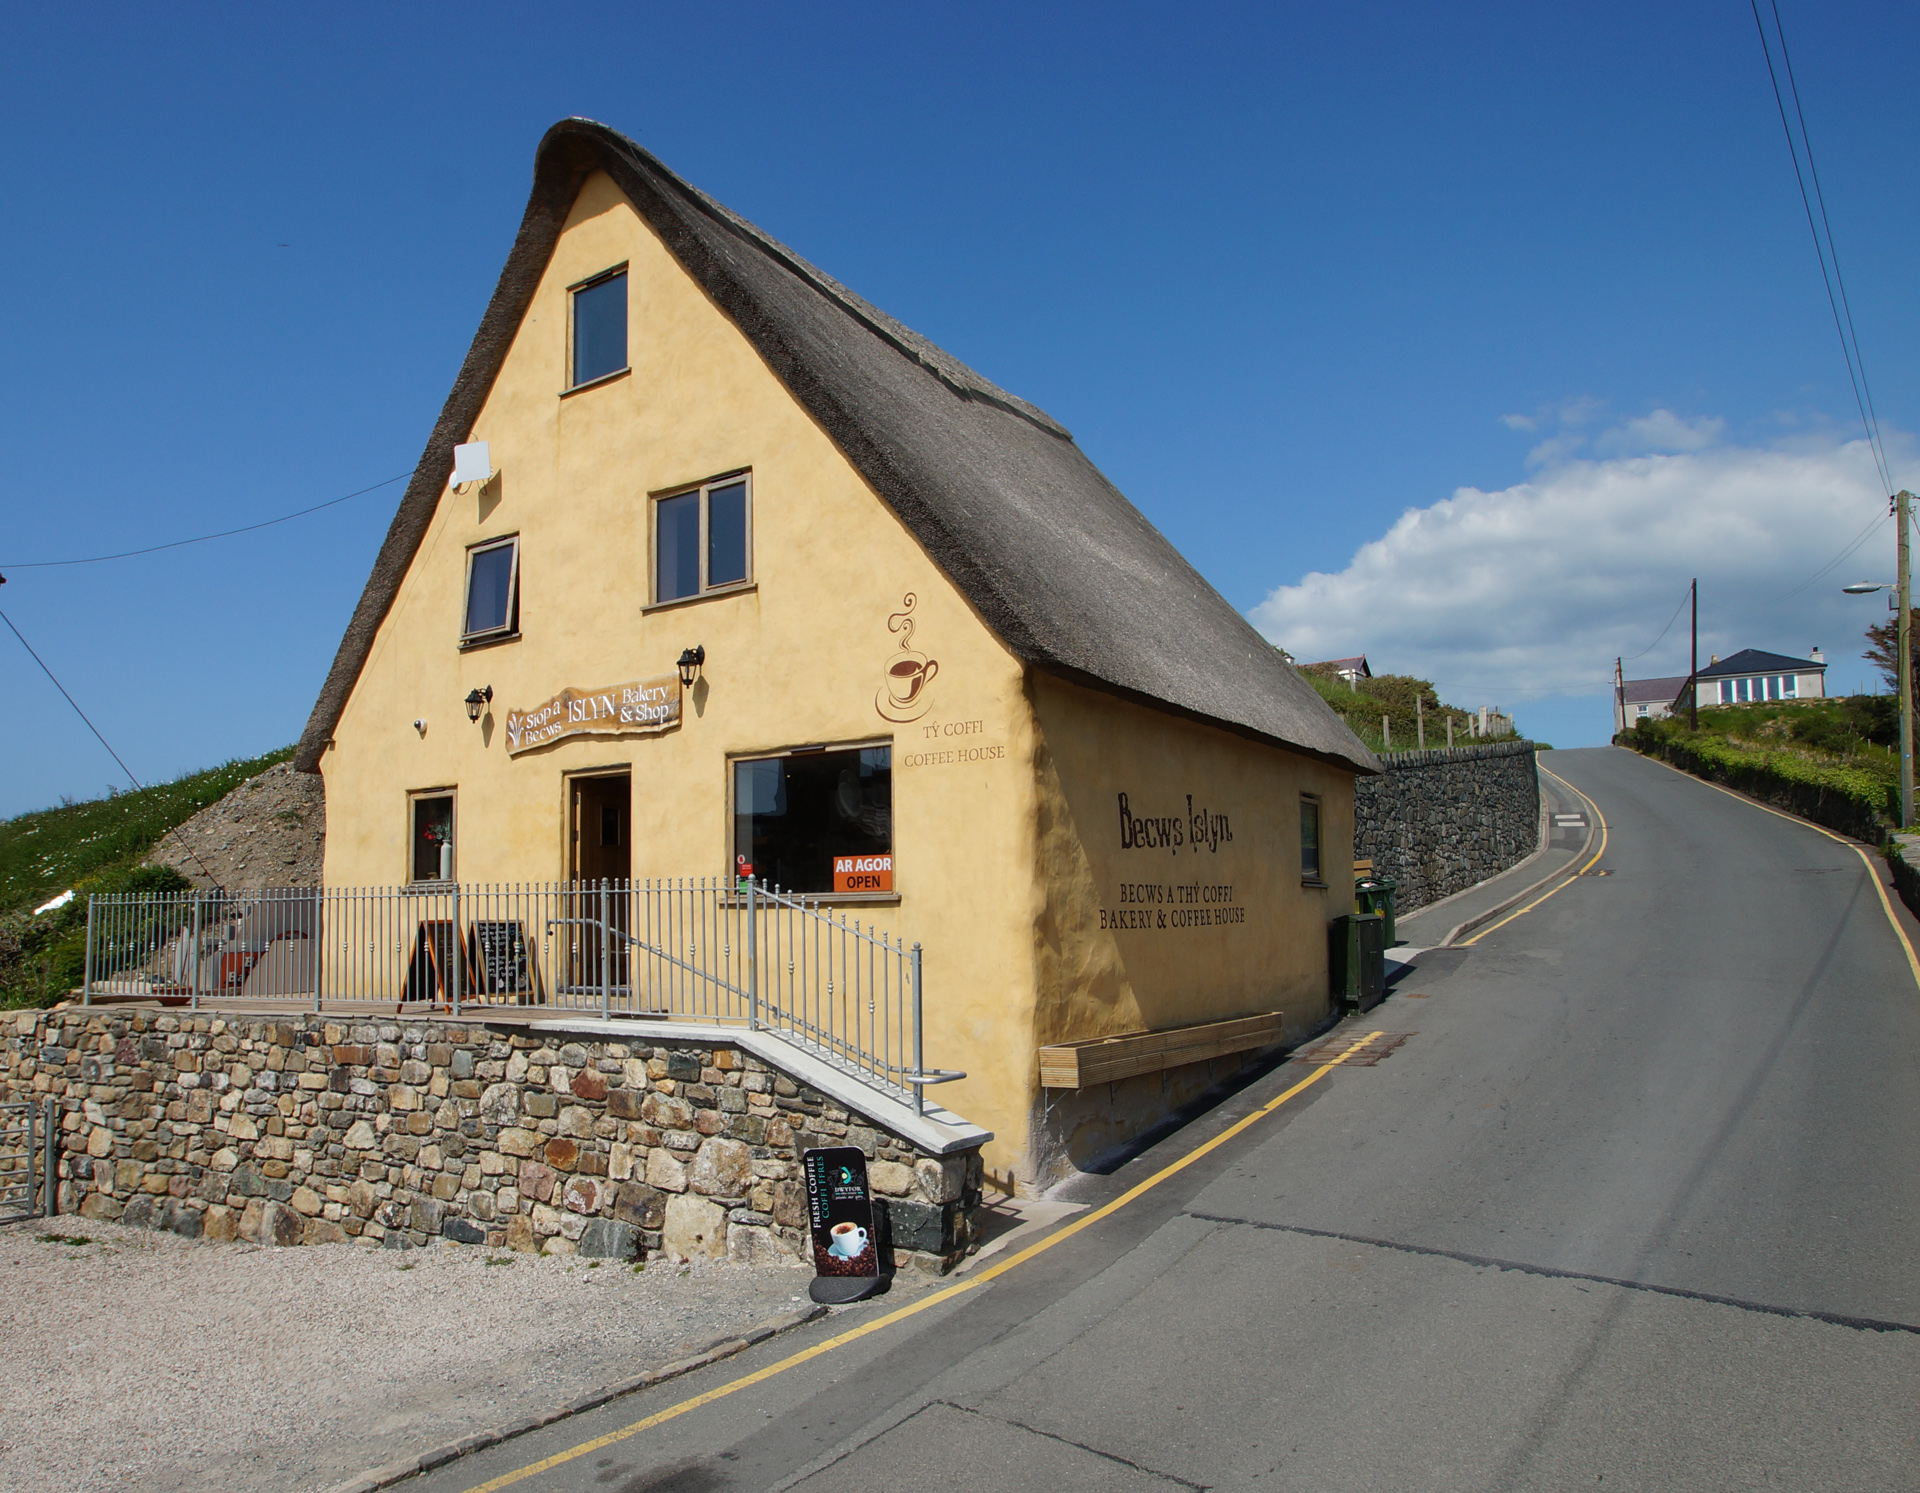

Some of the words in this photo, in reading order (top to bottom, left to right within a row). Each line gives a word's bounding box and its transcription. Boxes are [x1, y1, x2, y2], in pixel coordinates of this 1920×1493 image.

[622, 684, 669, 705] Bakery
[526, 706, 551, 731] Siop
[552, 701, 561, 715] a
[567, 694, 615, 723] ISLYN
[620, 706, 634, 723] &
[635, 703, 669, 723] Shop
[525, 721, 562, 745] Becws
[923, 721, 940, 739] TŶ
[943, 720, 984, 737] COFFI
[904, 750, 954, 768] COFFEE
[958, 745, 1005, 763] HOUSE
[1118, 792, 1183, 856] Becws
[1186, 794, 1233, 853] Islyn
[836, 859, 853, 873] AR
[855, 857, 892, 872] AGOR
[847, 875, 880, 889] OPEN
[1120, 883, 1163, 904] BECWS
[1166, 885, 1174, 904] A
[1203, 885, 1233, 903] COFFI
[1099, 909, 1153, 930] BAKERY
[1156, 909, 1167, 929] &
[1171, 908, 1212, 928] COFFEE
[1214, 907, 1245, 925] HOUSE
[807, 1156, 817, 1194] COFFEE
[817, 1156, 826, 1184] FFRES
[812, 1198, 821, 1229] FRESH
[820, 1188, 829, 1218] COFFI
